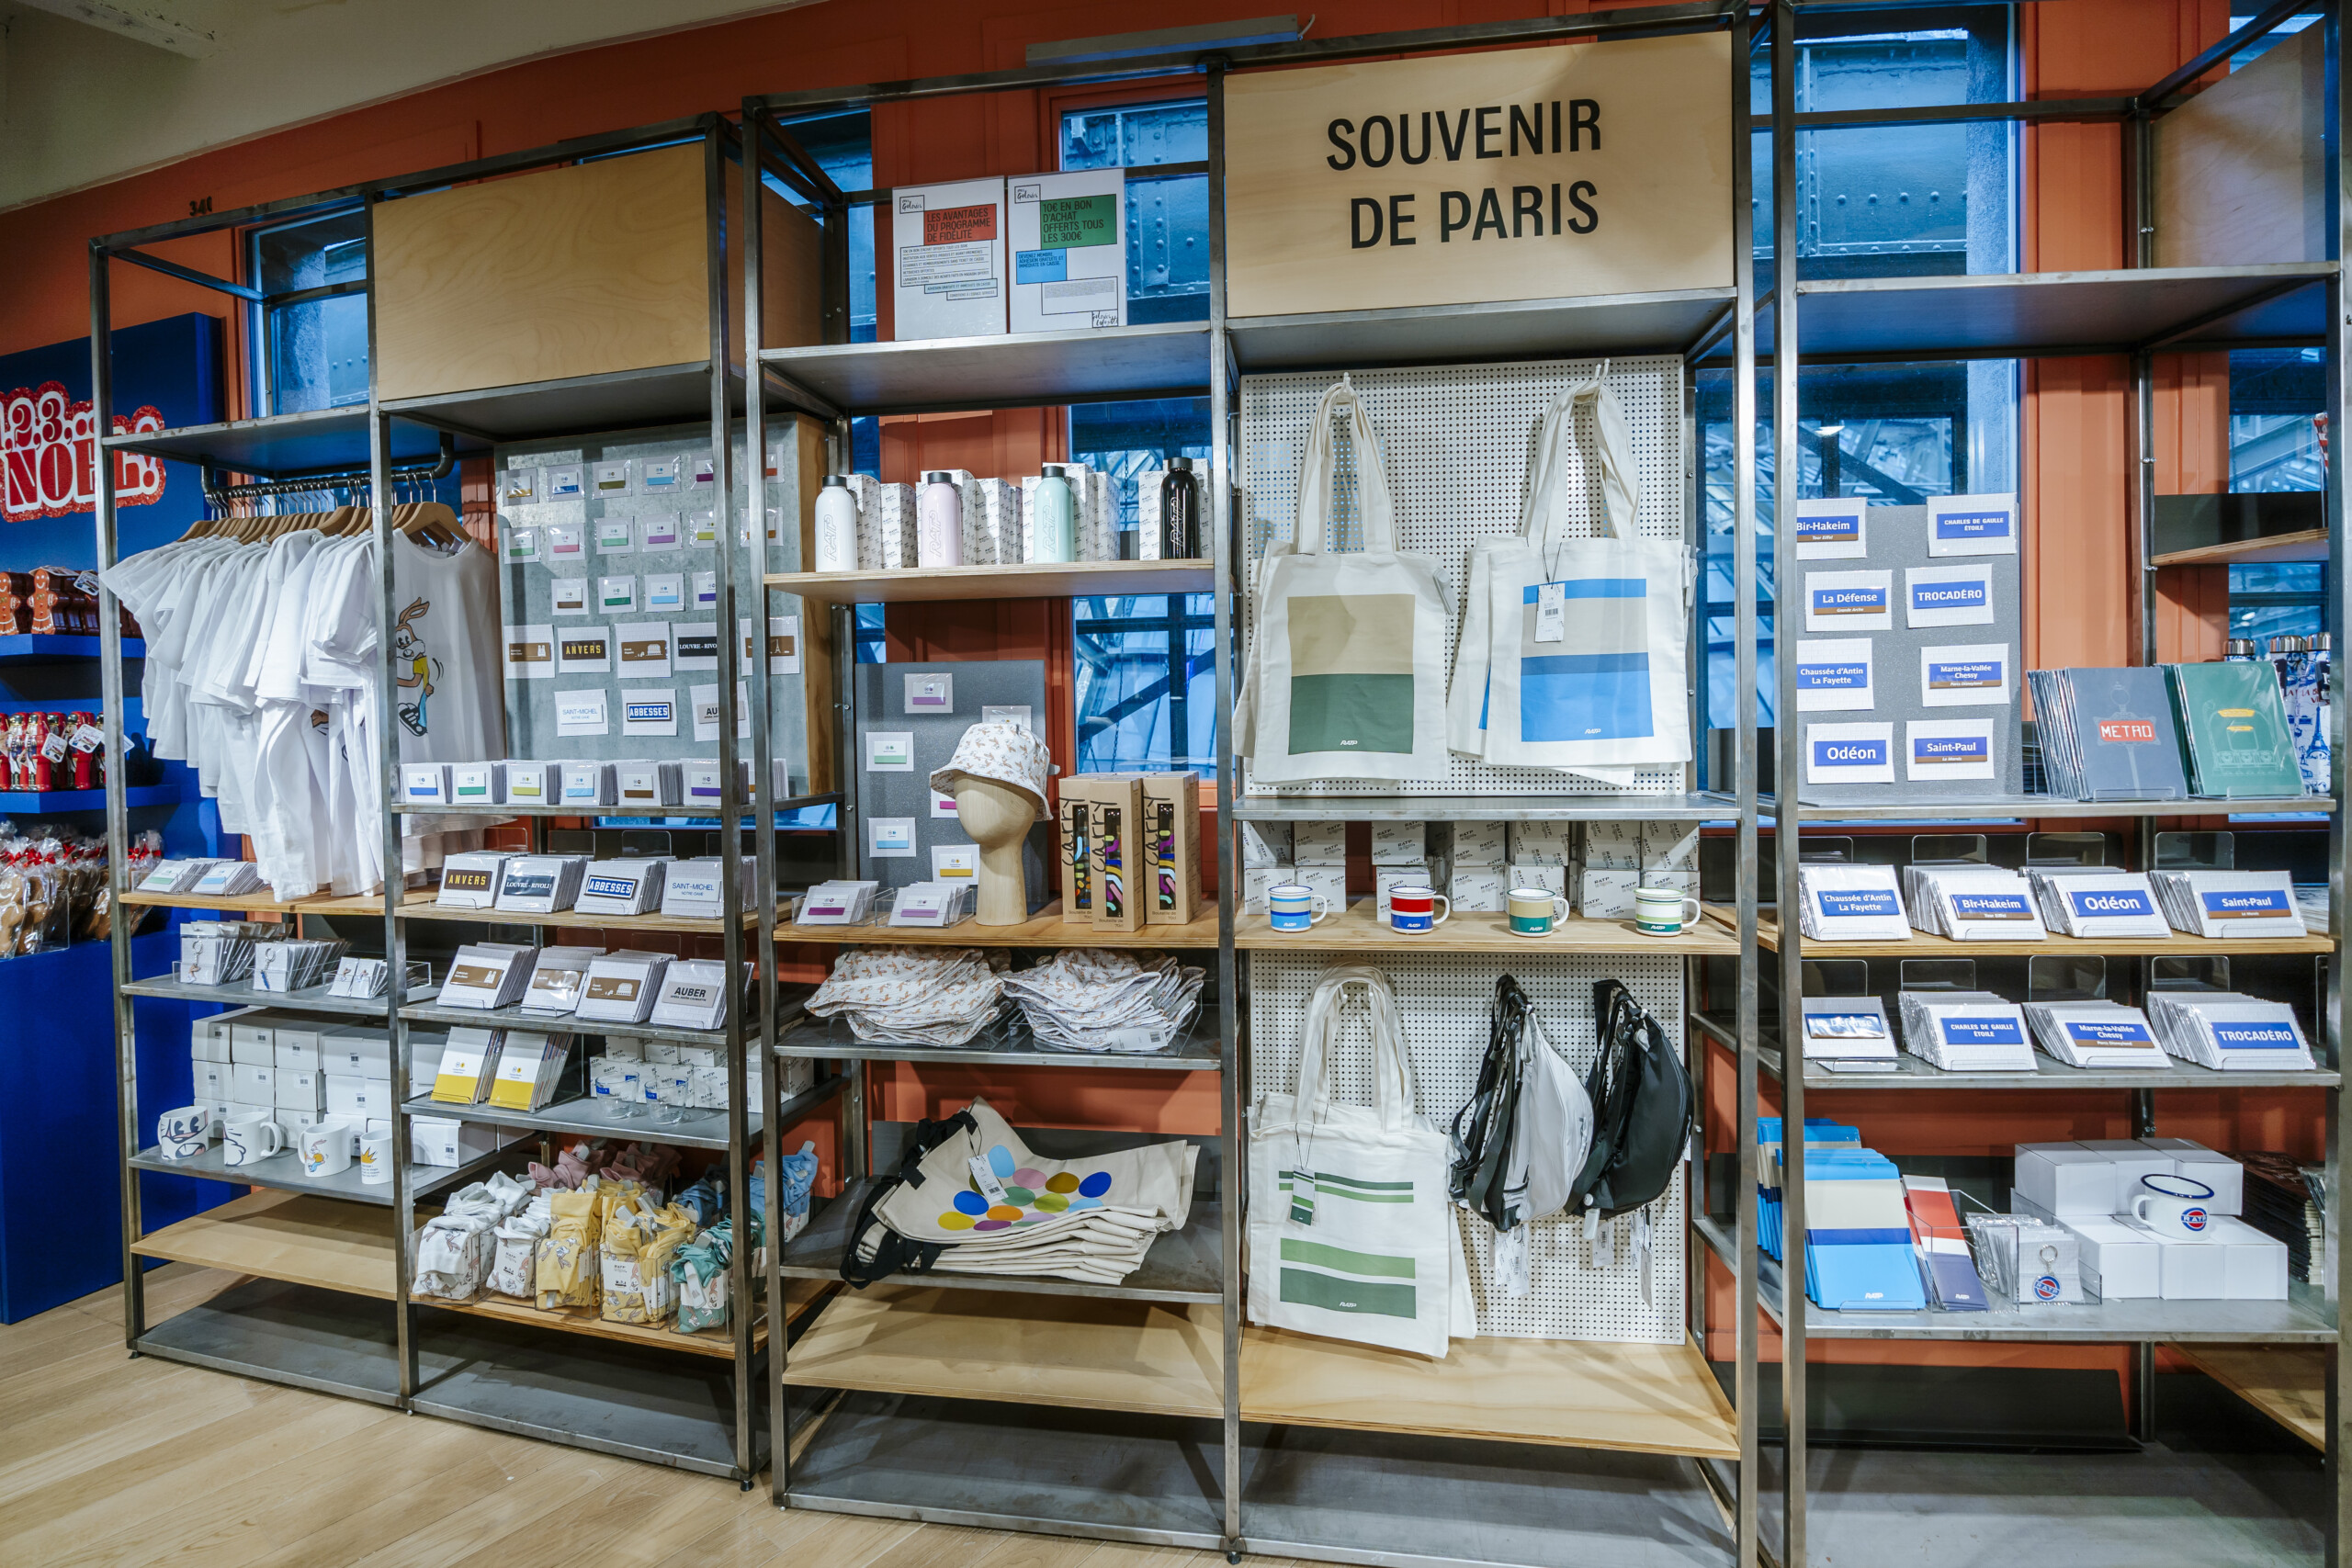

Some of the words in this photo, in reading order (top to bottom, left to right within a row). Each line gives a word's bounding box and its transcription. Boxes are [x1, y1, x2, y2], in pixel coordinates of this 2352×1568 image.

[1326, 98, 1601, 171] SOUVENIR
[1043, 203, 1057, 212] 10€
[1060, 201, 1071, 211] EN
[1074, 199, 1092, 210] BON
[927, 213, 941, 222] LES
[943, 208, 989, 220] AVANTAGES
[1044, 211, 1077, 222] D'ACHAT
[1351, 194, 1417, 249] DE
[1441, 180, 1599, 243] PARIS
[927, 223, 938, 232] DU
[940, 218, 991, 231] PROGRAMME
[1044, 221, 1080, 232] OFFERTS
[1082, 220, 1104, 230] TOUS
[927, 232, 937, 242] DE
[939, 228, 972, 241] FIDÉLITÉ
[1044, 233, 1057, 243] LES
[1061, 231, 1082, 242] 300€
[0, 398, 73, 452] ,2,3,
[1170, 497, 1183, 547] RATP
[1796, 521, 1849, 531] Bir-Hakeim
[928, 510, 941, 558] RATP
[1043, 506, 1056, 553] RATP
[824, 514, 836, 561] RATP
[1823, 594, 1834, 604] La
[1837, 593, 1878, 602] Défense
[1917, 589, 1983, 602] TROCADÉRO
[565, 645, 601, 655] ANVERS
[1800, 668, 1835, 676] Chaussée
[1823, 676, 1852, 685] Fayette
[629, 706, 668, 716] ABBESSES
[2100, 724, 2153, 739] METRO
[1927, 742, 1976, 752] Saint-Paul
[1827, 747, 1876, 761] Odéon
[1327, 823, 1341, 831] RATP
[1615, 823, 1623, 839] RATP
[1296, 835, 1310, 843] RATP
[1459, 829, 1474, 838] RATP
[1260, 843, 1268, 858] RATP
[1455, 850, 1470, 858] RATP
[448, 874, 487, 885] ANVERS
[1306, 872, 1320, 880] RATP
[1454, 874, 1469, 883] RATP
[589, 881, 633, 894] ABBESSES
[672, 882, 714, 891] SAINT-MICHEL
[1850, 903, 1882, 912] Fayette
[1962, 899, 2021, 909] Bir-Hakeim
[2085, 896, 2141, 910] Odéon
[2222, 897, 2272, 908] Saint-Paul
[674, 987, 707, 998] AUBER
[2078, 1024, 2134, 1033] Marne-la-Vallée
[2097, 1032, 2123, 1040] Chessy
[2219, 1029, 2293, 1042] TROCADÉRO
[2036, 1282, 2059, 1295] RATP
